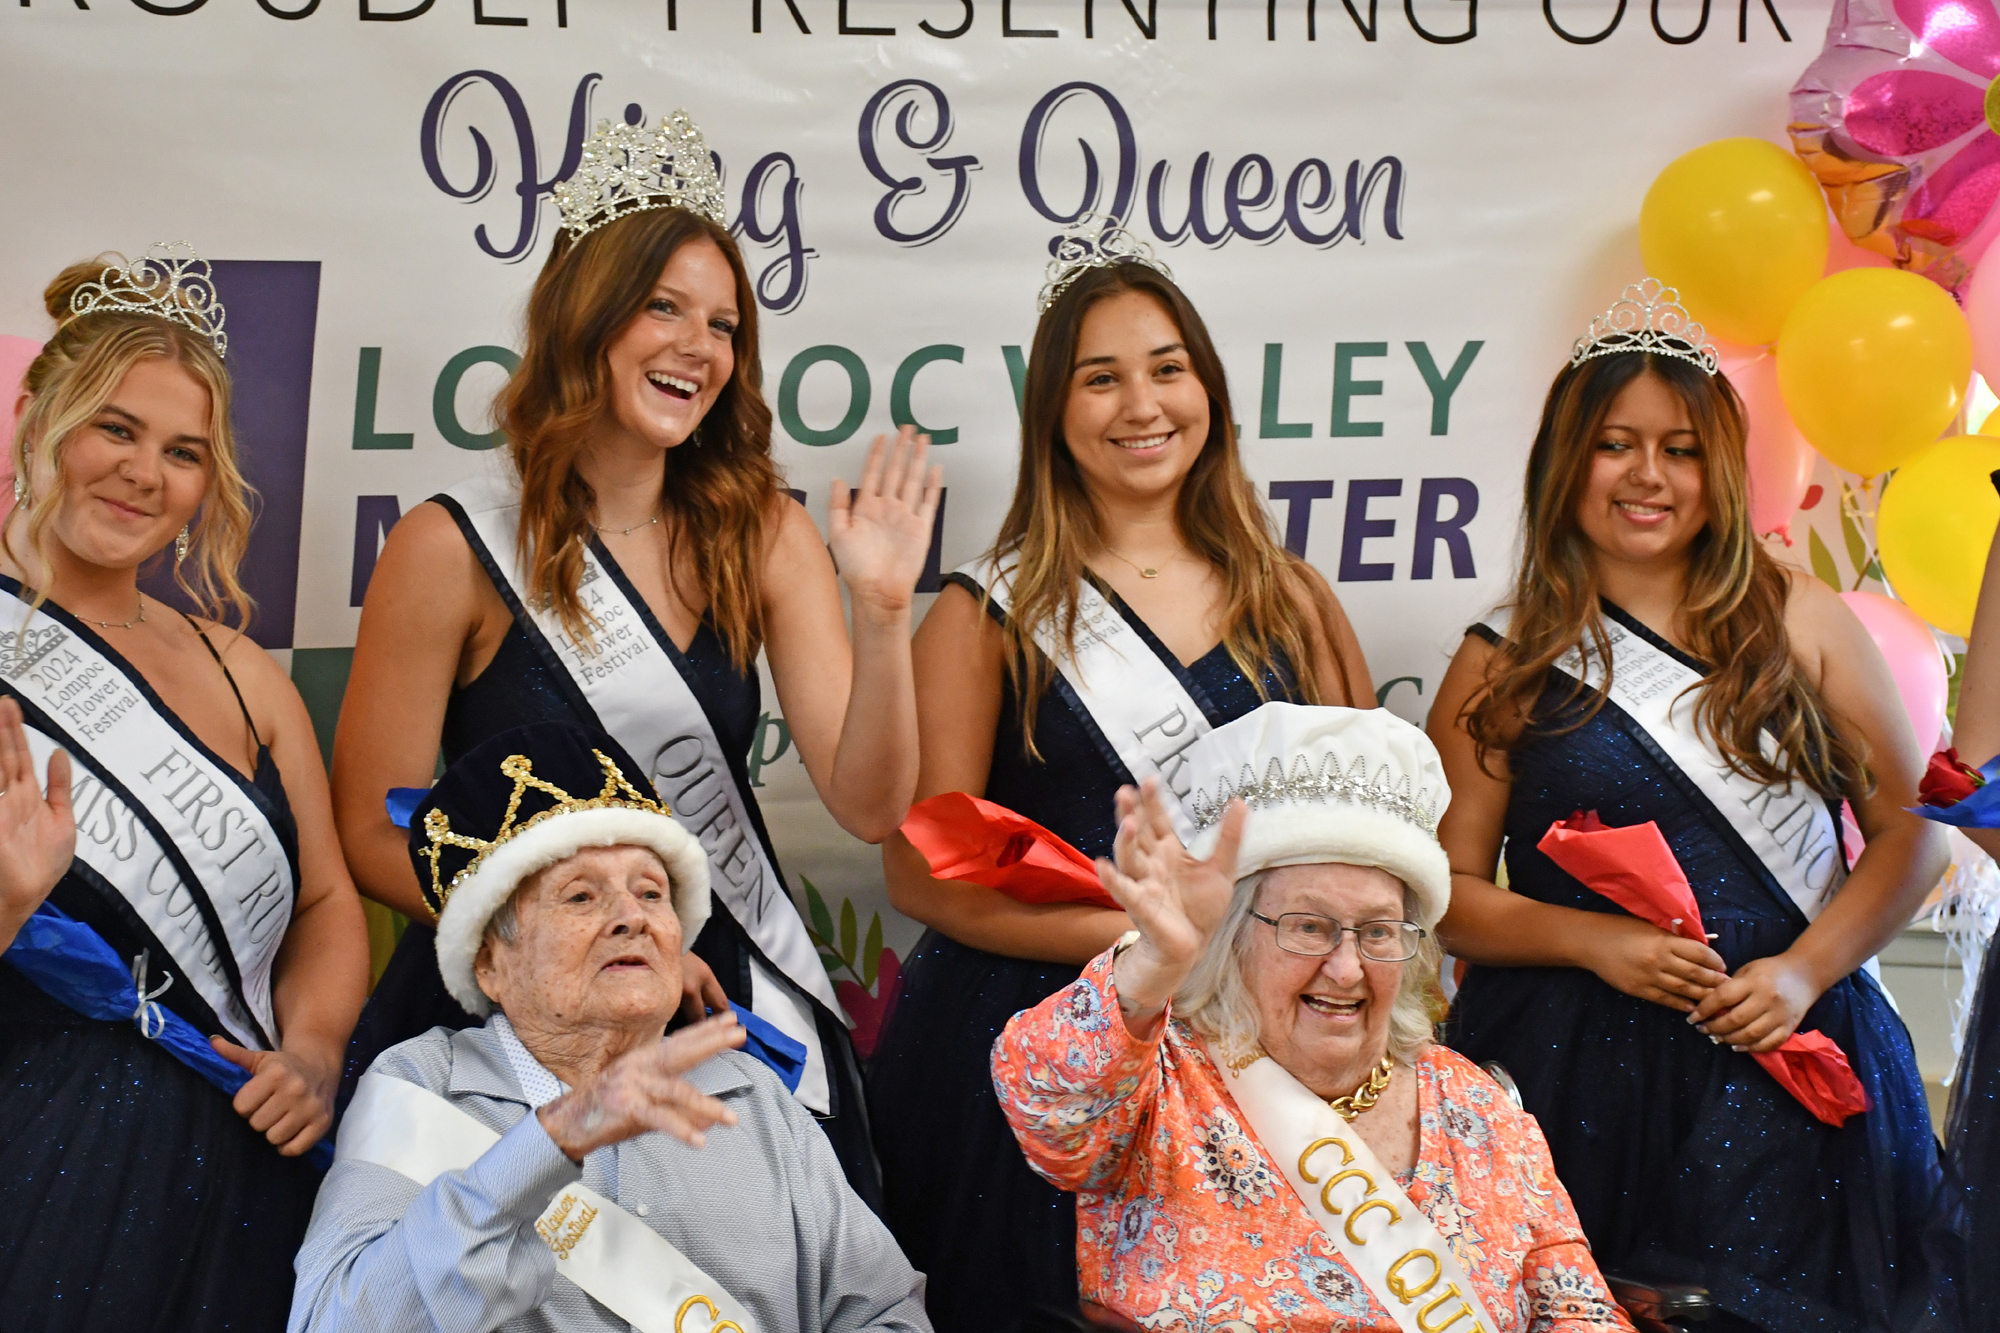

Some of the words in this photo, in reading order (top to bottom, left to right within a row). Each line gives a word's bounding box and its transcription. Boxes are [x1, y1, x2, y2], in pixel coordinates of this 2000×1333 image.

[420, 69, 820, 316] Kg
[858, 79, 983, 247] &
[1019, 81, 1405, 262] Queen
[352, 344, 965, 450] LOOC
[30, 649, 82, 692] 2024
[572, 623, 633, 667] Flower
[580, 635, 650, 686] Festival
[1587, 645, 1637, 674] 224
[1597, 651, 1657, 683] ompoc
[42, 662, 105, 711] Lompoc
[63, 678, 121, 725] Flower
[1615, 661, 1669, 695] Flower
[1626, 666, 1688, 706] Festival
[78, 688, 139, 742] Festival
[140, 745, 267, 877] FIRST
[650, 734, 777, 924] QUEEN
[535, 1193, 578, 1244] Flower
[551, 1199, 598, 1260] Festival
[1297, 1137, 1403, 1246] CCC
[1386, 1248, 1487, 1333] QU
